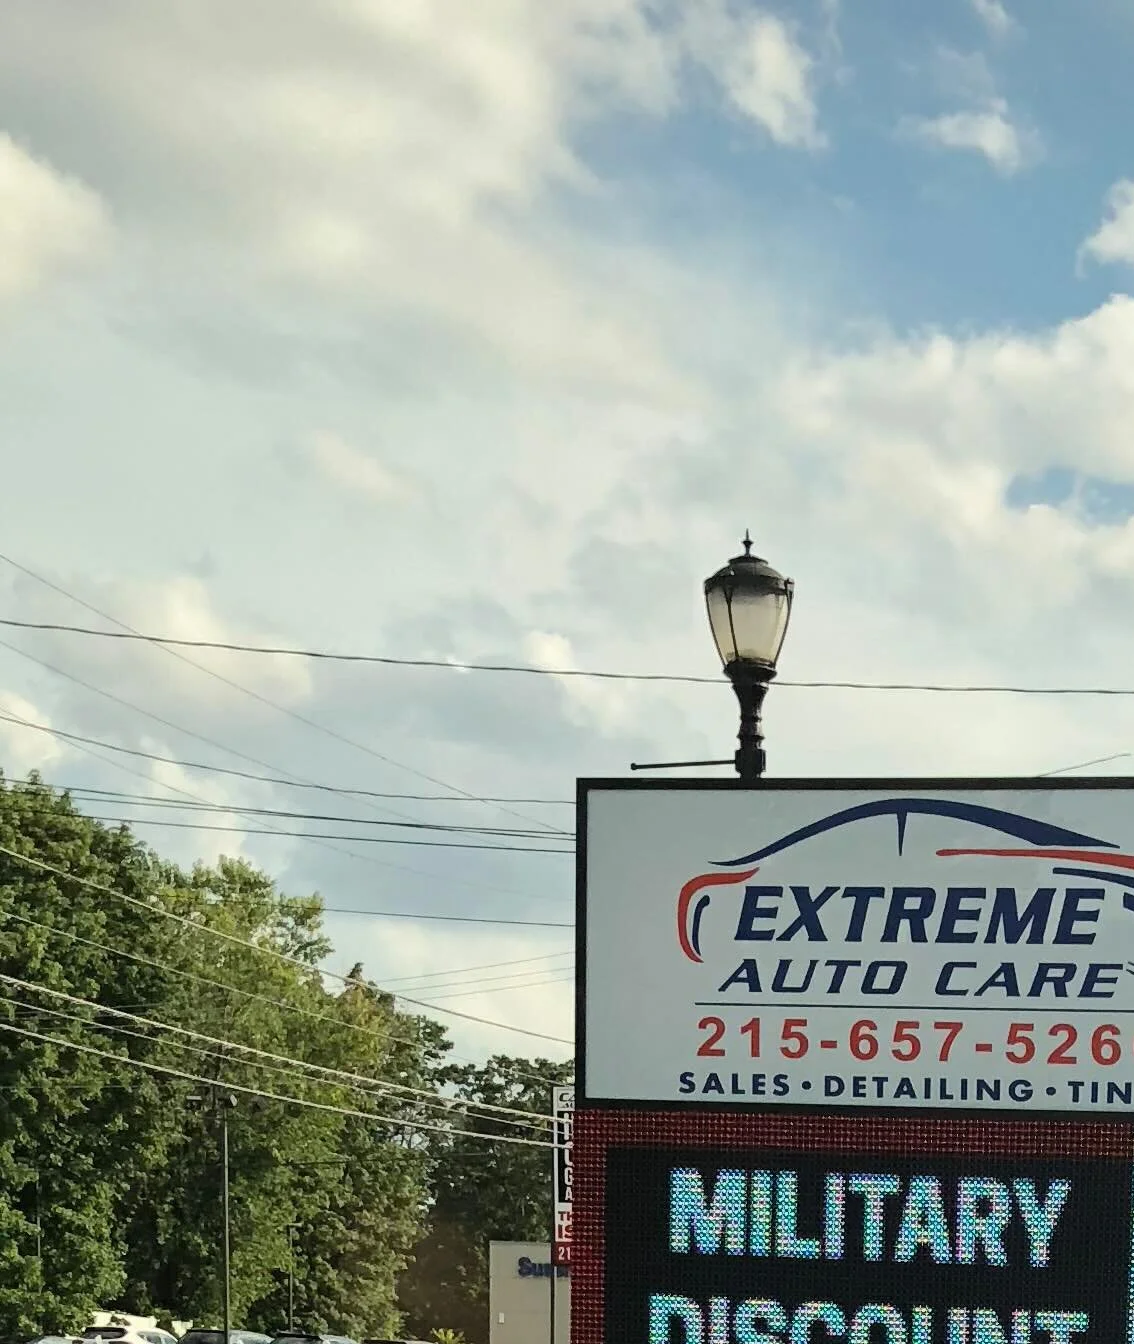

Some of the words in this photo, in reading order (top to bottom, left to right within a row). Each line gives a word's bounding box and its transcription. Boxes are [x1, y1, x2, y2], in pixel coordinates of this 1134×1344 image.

[734, 886, 1105, 945] EXTREME
[718, 958, 908, 995] AUTO
[935, 961, 1124, 998] CARE
[679, 1071, 791, 1097] SALES
[824, 1075, 1035, 1102] DETAILING
[669, 1167, 1072, 1268] MILITARY
